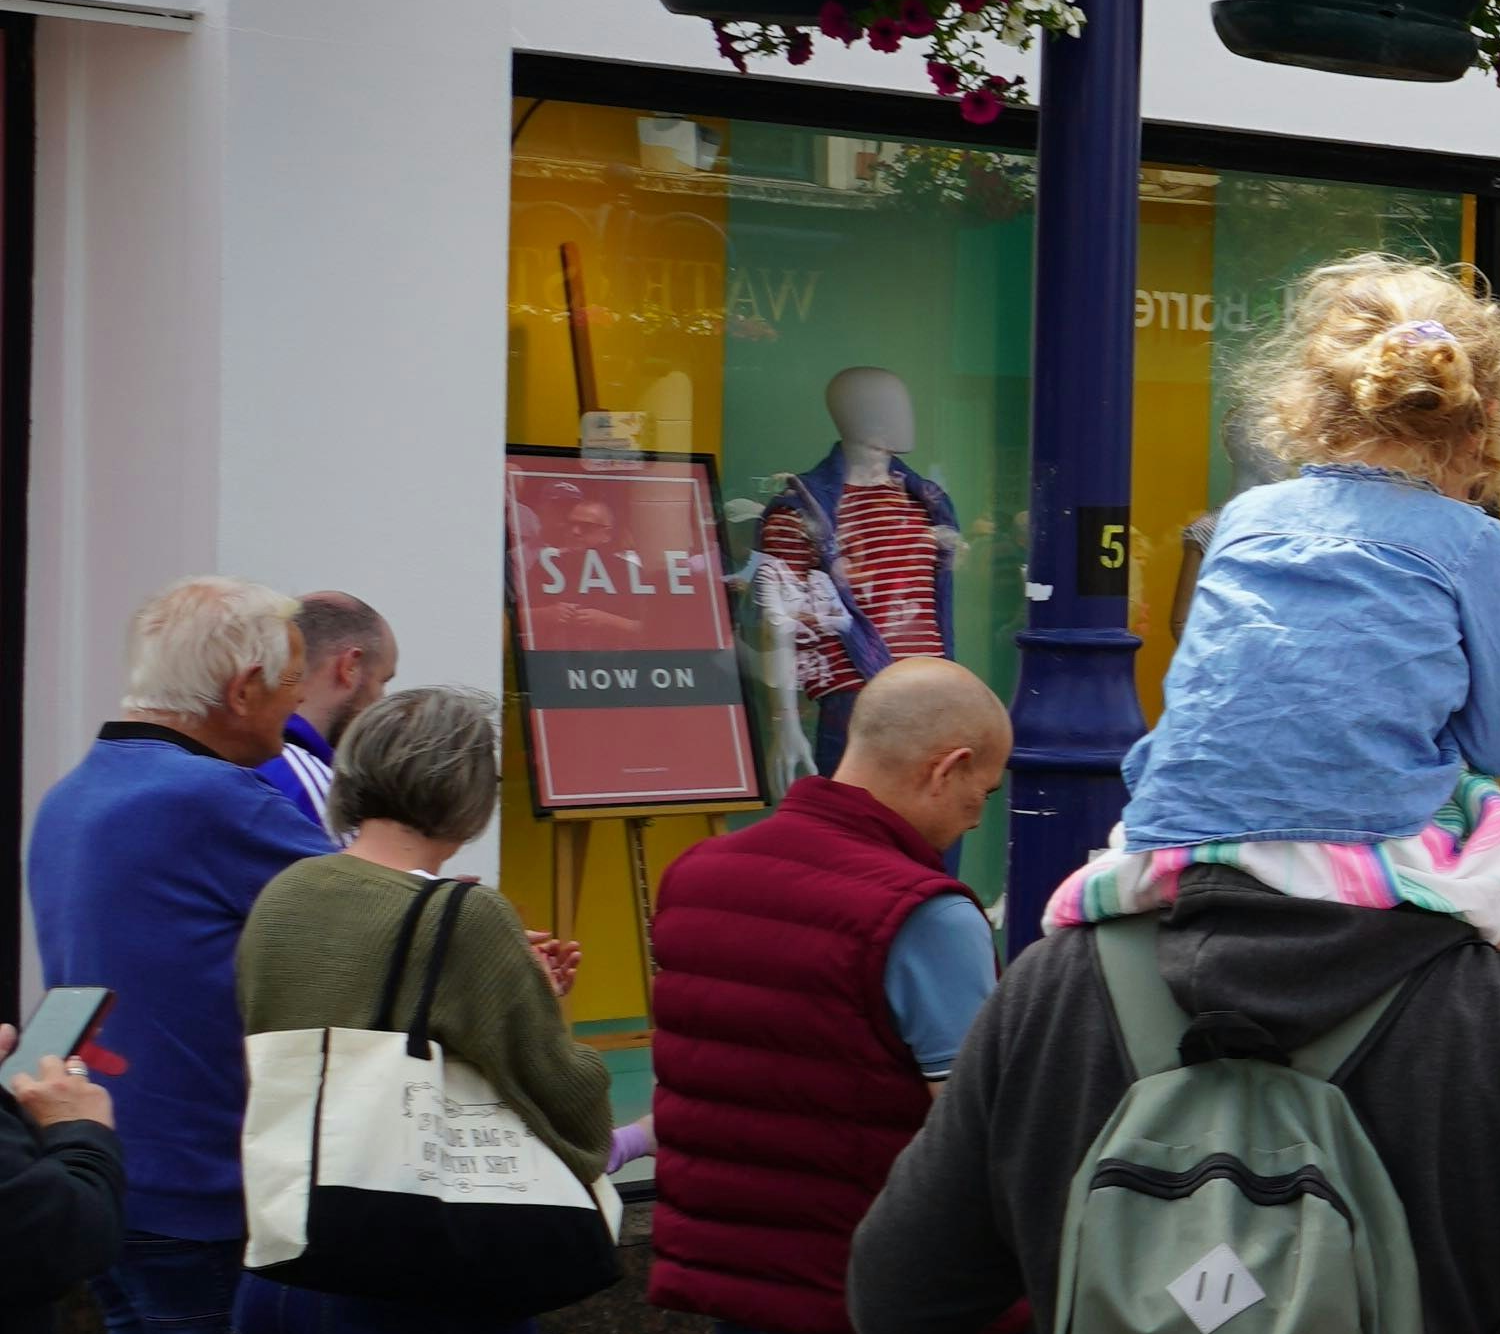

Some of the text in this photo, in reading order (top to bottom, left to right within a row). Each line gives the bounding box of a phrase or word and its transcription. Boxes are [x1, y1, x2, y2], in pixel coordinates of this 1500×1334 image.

[1100, 524, 1125, 569] 5
[539, 547, 696, 595] SALE
[568, 668, 695, 690] NOW ON
